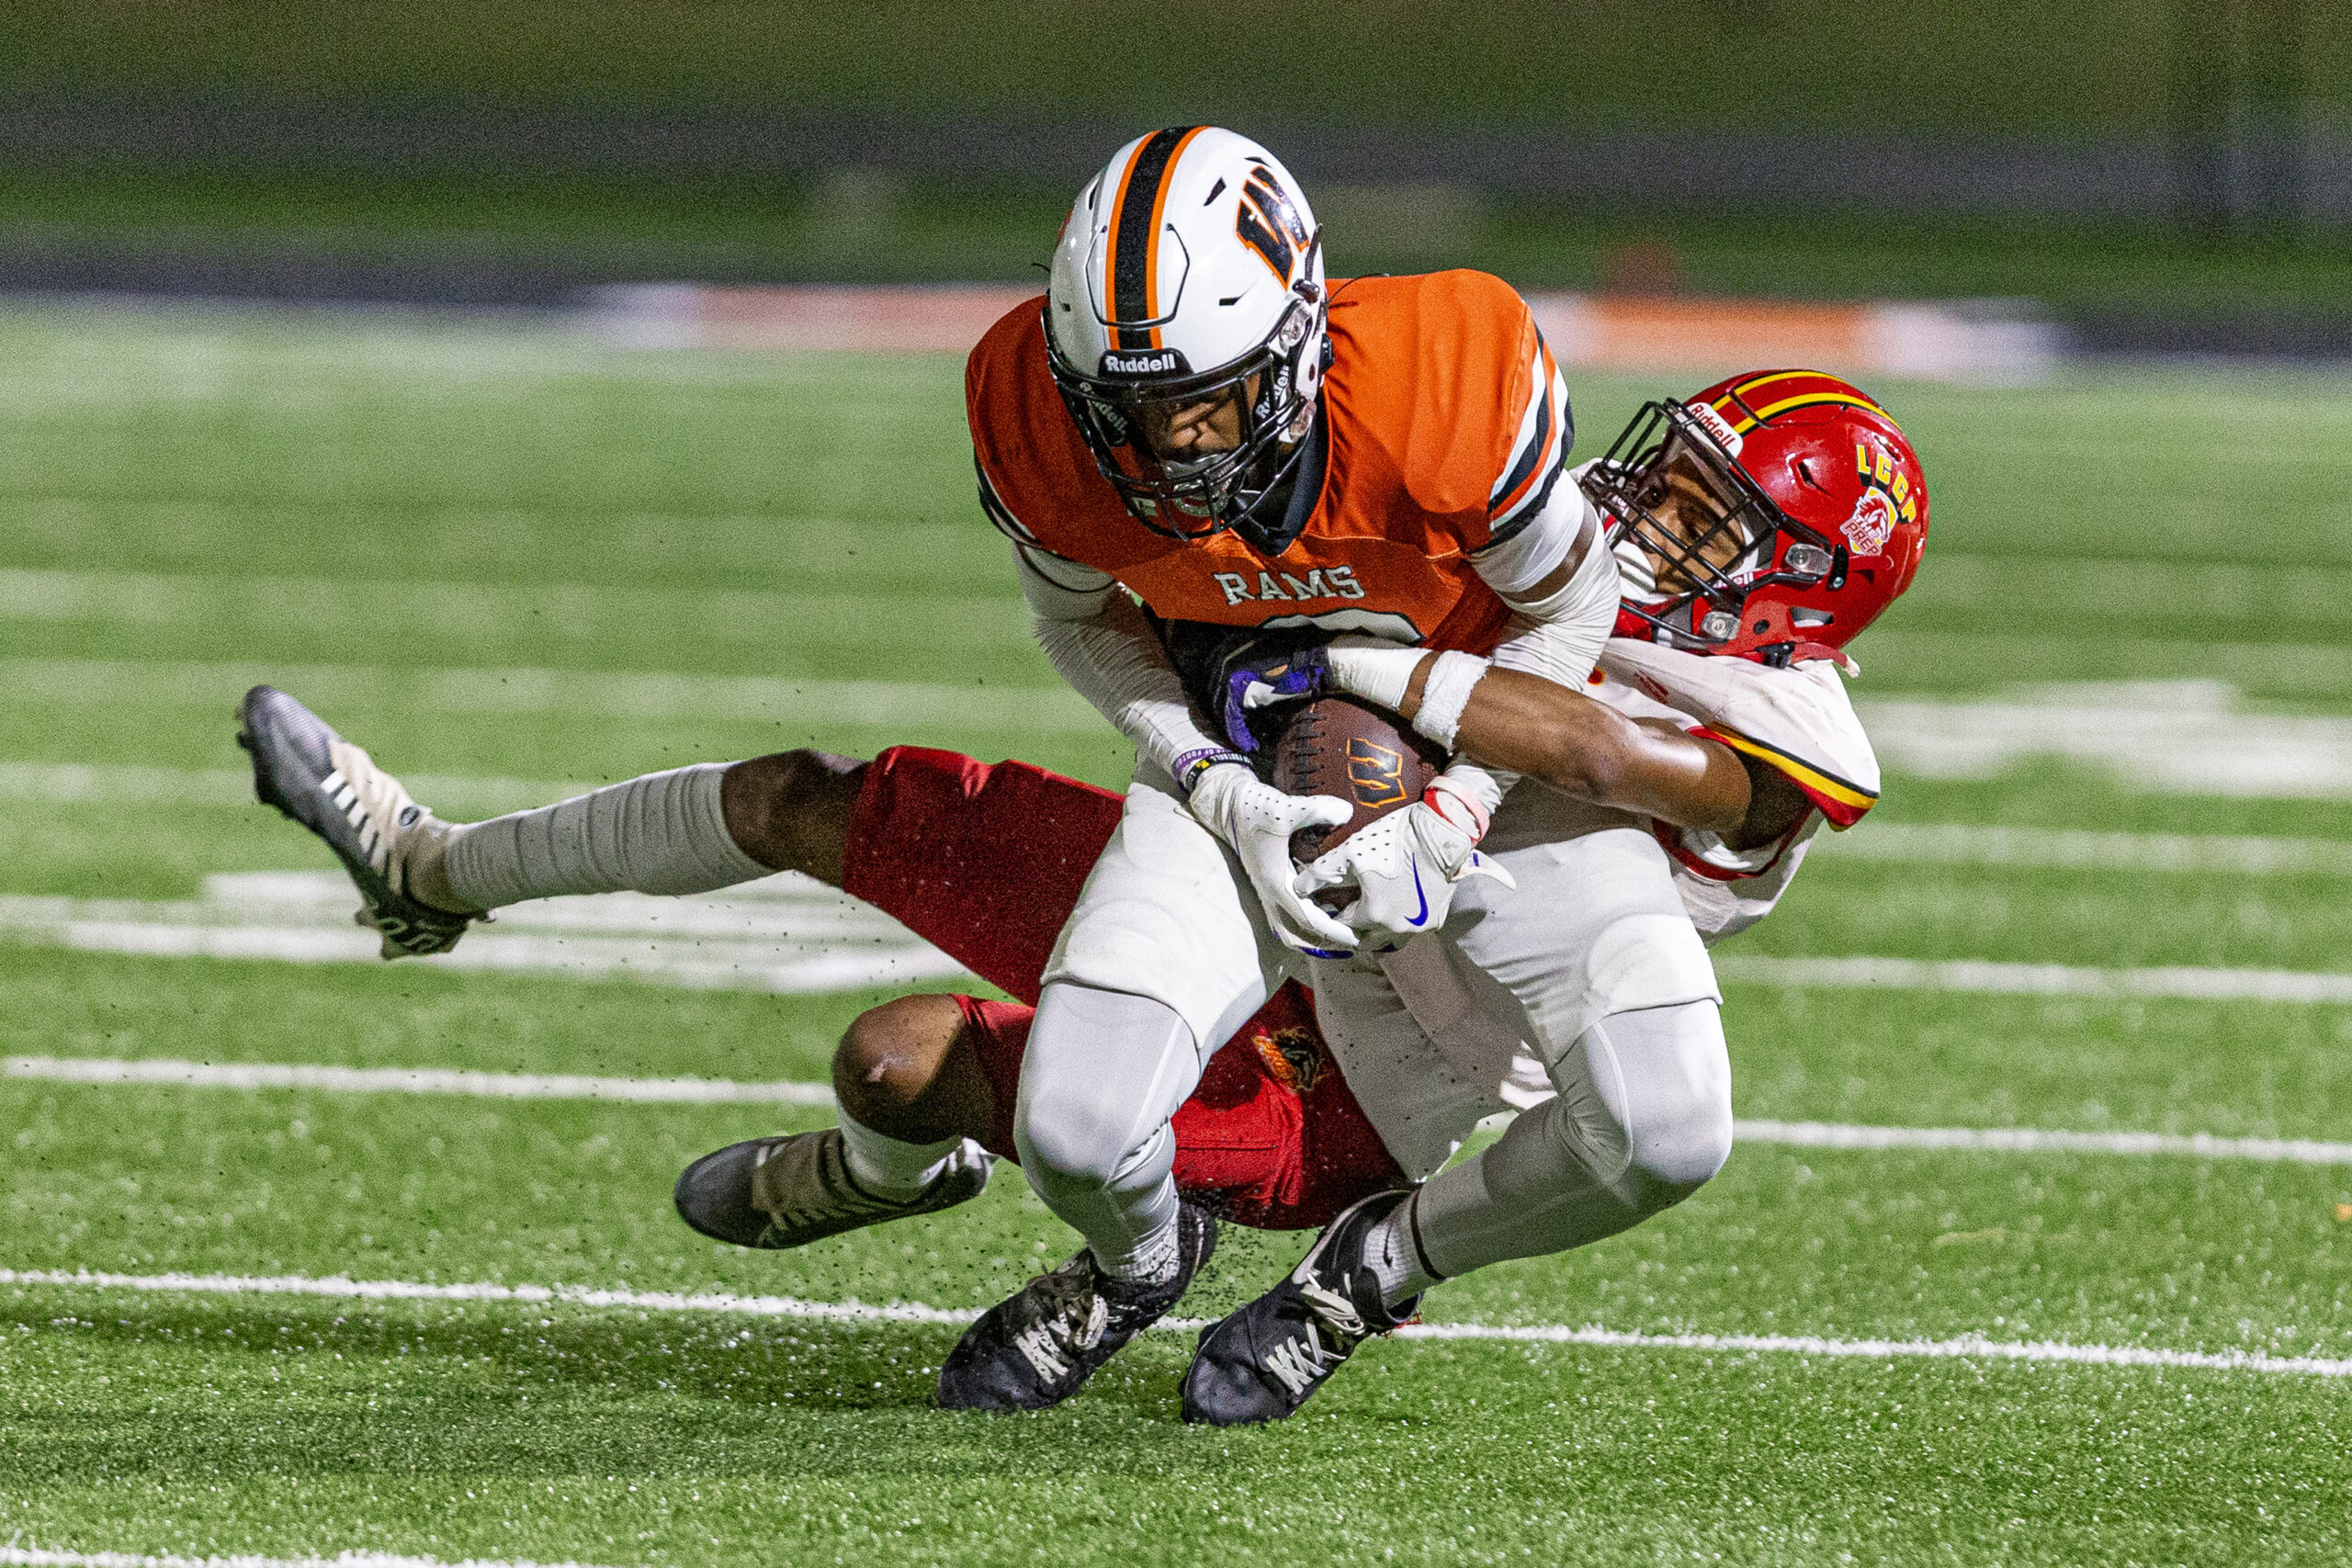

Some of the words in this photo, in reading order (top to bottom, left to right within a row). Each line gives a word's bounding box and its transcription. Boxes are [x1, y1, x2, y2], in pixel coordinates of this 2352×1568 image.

[1105, 354, 1176, 372] Riddell
[1255, 365, 1290, 420] Ridell
[1690, 404, 1736, 447] Riddell
[1856, 444, 1917, 524] LCCP
[1840, 519, 1882, 555] PREP
[1212, 564, 1367, 606] RAMS
